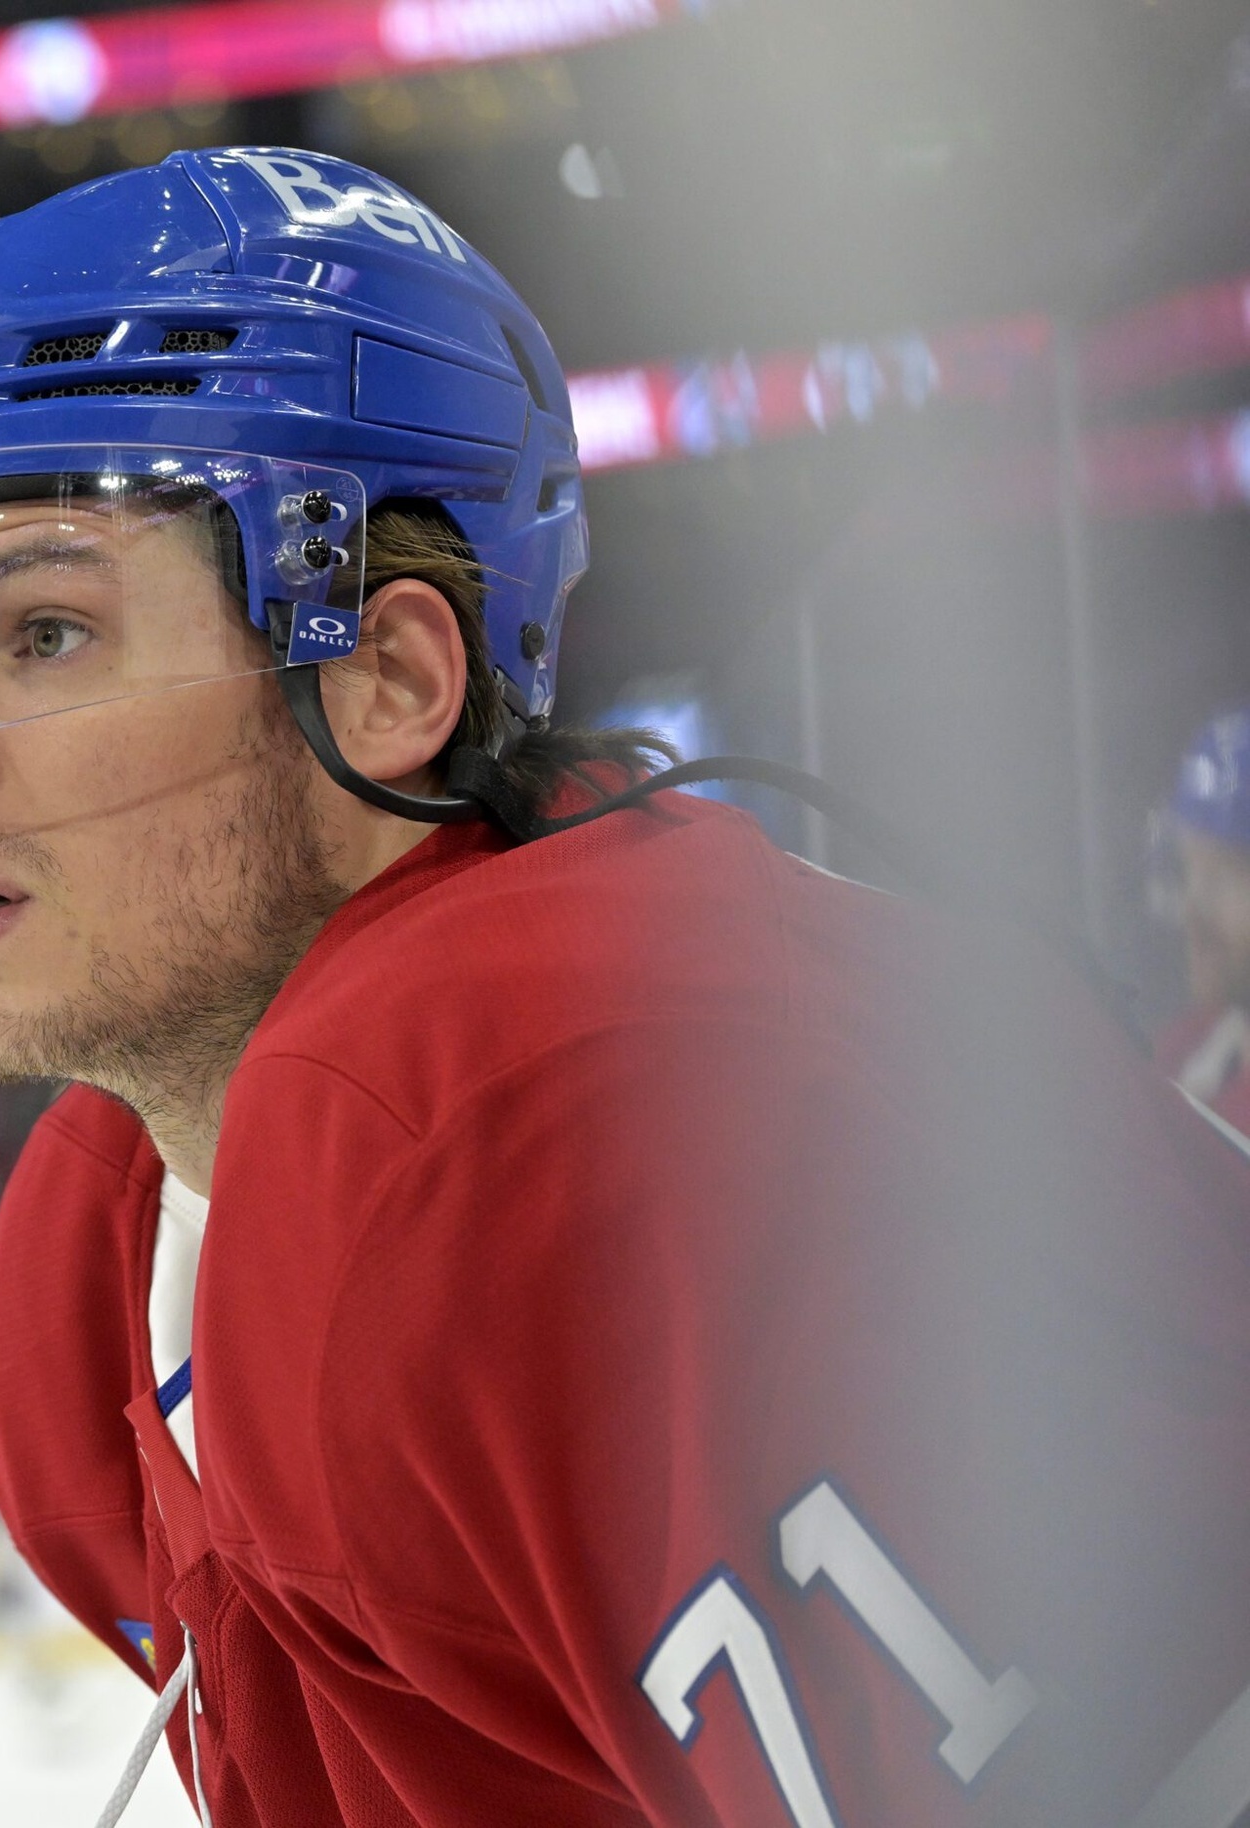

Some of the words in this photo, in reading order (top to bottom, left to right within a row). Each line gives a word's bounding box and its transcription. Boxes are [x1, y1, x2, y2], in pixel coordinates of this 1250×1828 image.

[241, 155, 467, 264] Bell
[298, 630, 355, 648] OAKLEY
[638, 1478, 1040, 1828] 71
